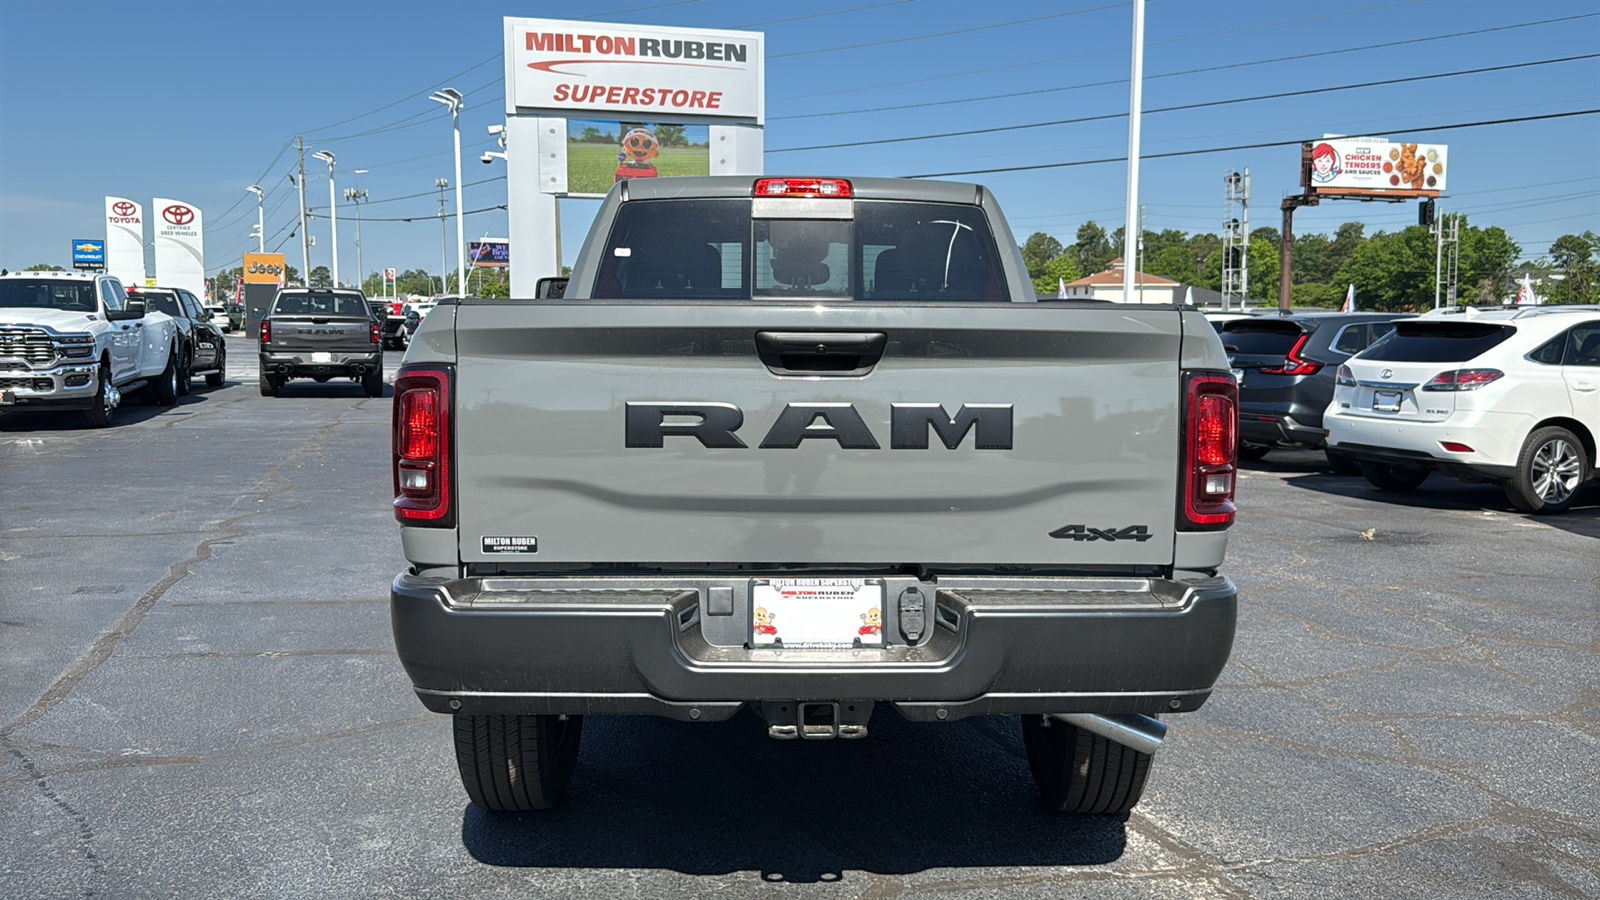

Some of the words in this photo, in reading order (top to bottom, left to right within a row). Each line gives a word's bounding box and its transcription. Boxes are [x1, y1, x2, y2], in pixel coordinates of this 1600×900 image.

[525, 32, 635, 56] MILTON
[639, 38, 747, 62] RUBEN
[553, 84, 723, 109] SUPERSTORE
[108, 216, 141, 224] TOYOTA
[247, 261, 282, 276] Jeep
[625, 401, 1014, 450] RAM
[484, 537, 510, 545] MILTON
[511, 537, 535, 545] RUBEN
[1048, 524, 1154, 542] 4x4
